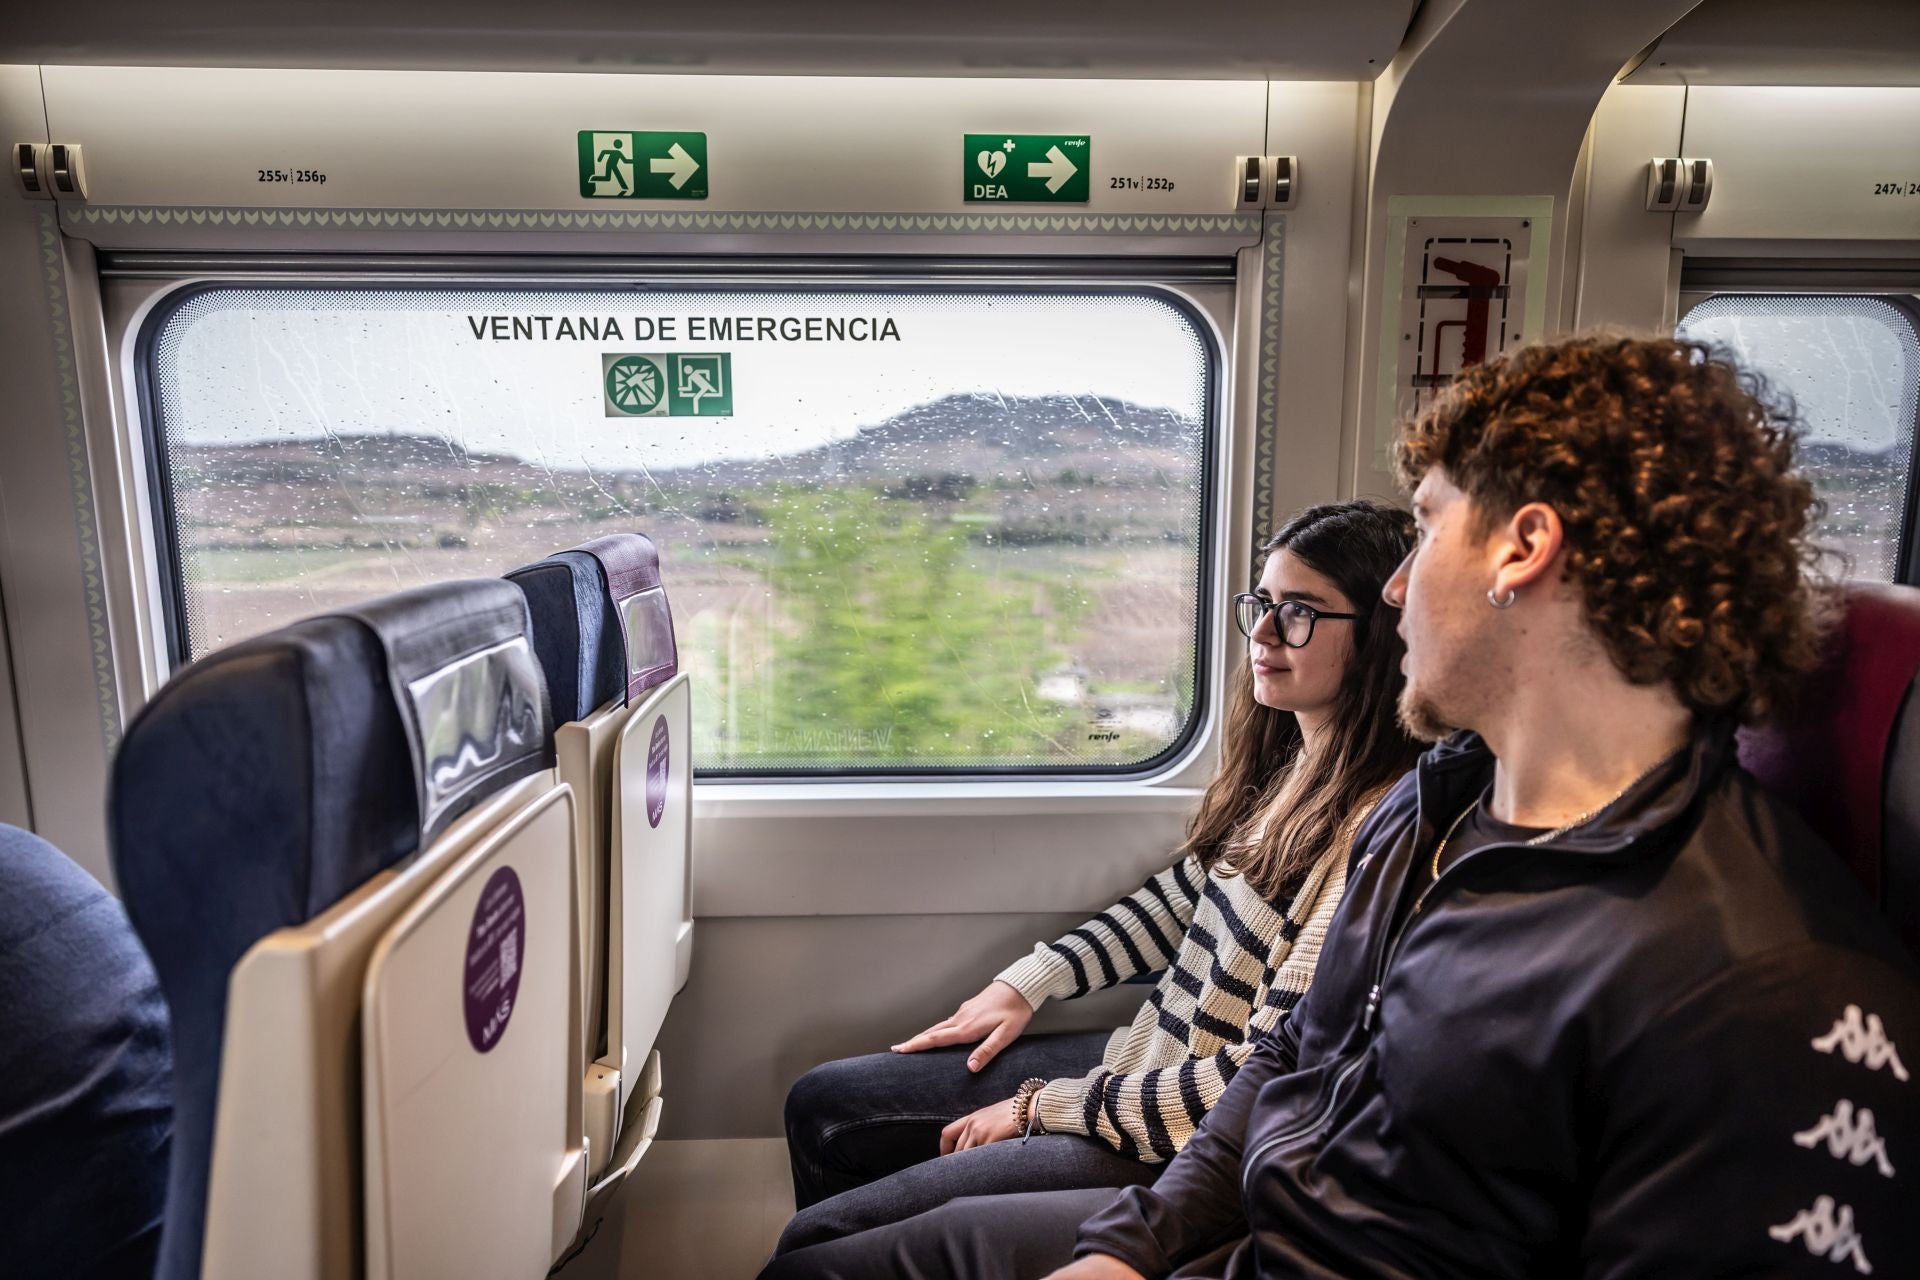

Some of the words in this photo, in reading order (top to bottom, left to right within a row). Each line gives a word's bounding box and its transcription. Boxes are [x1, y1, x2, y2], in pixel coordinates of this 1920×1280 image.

[1064, 138, 1086, 148] renfe
[258, 170, 288, 182] 255v
[296, 170, 327, 184] 256p
[973, 184, 1009, 199] DEA
[1110, 177, 1139, 189] 251v
[1146, 178, 1175, 192] 252p
[1874, 183, 1902, 195] 247v
[467, 315, 625, 341] VENTANA
[634, 316, 677, 341] DE
[688, 317, 902, 342] EMERGENCIA
[1088, 731, 1120, 742] renfe
